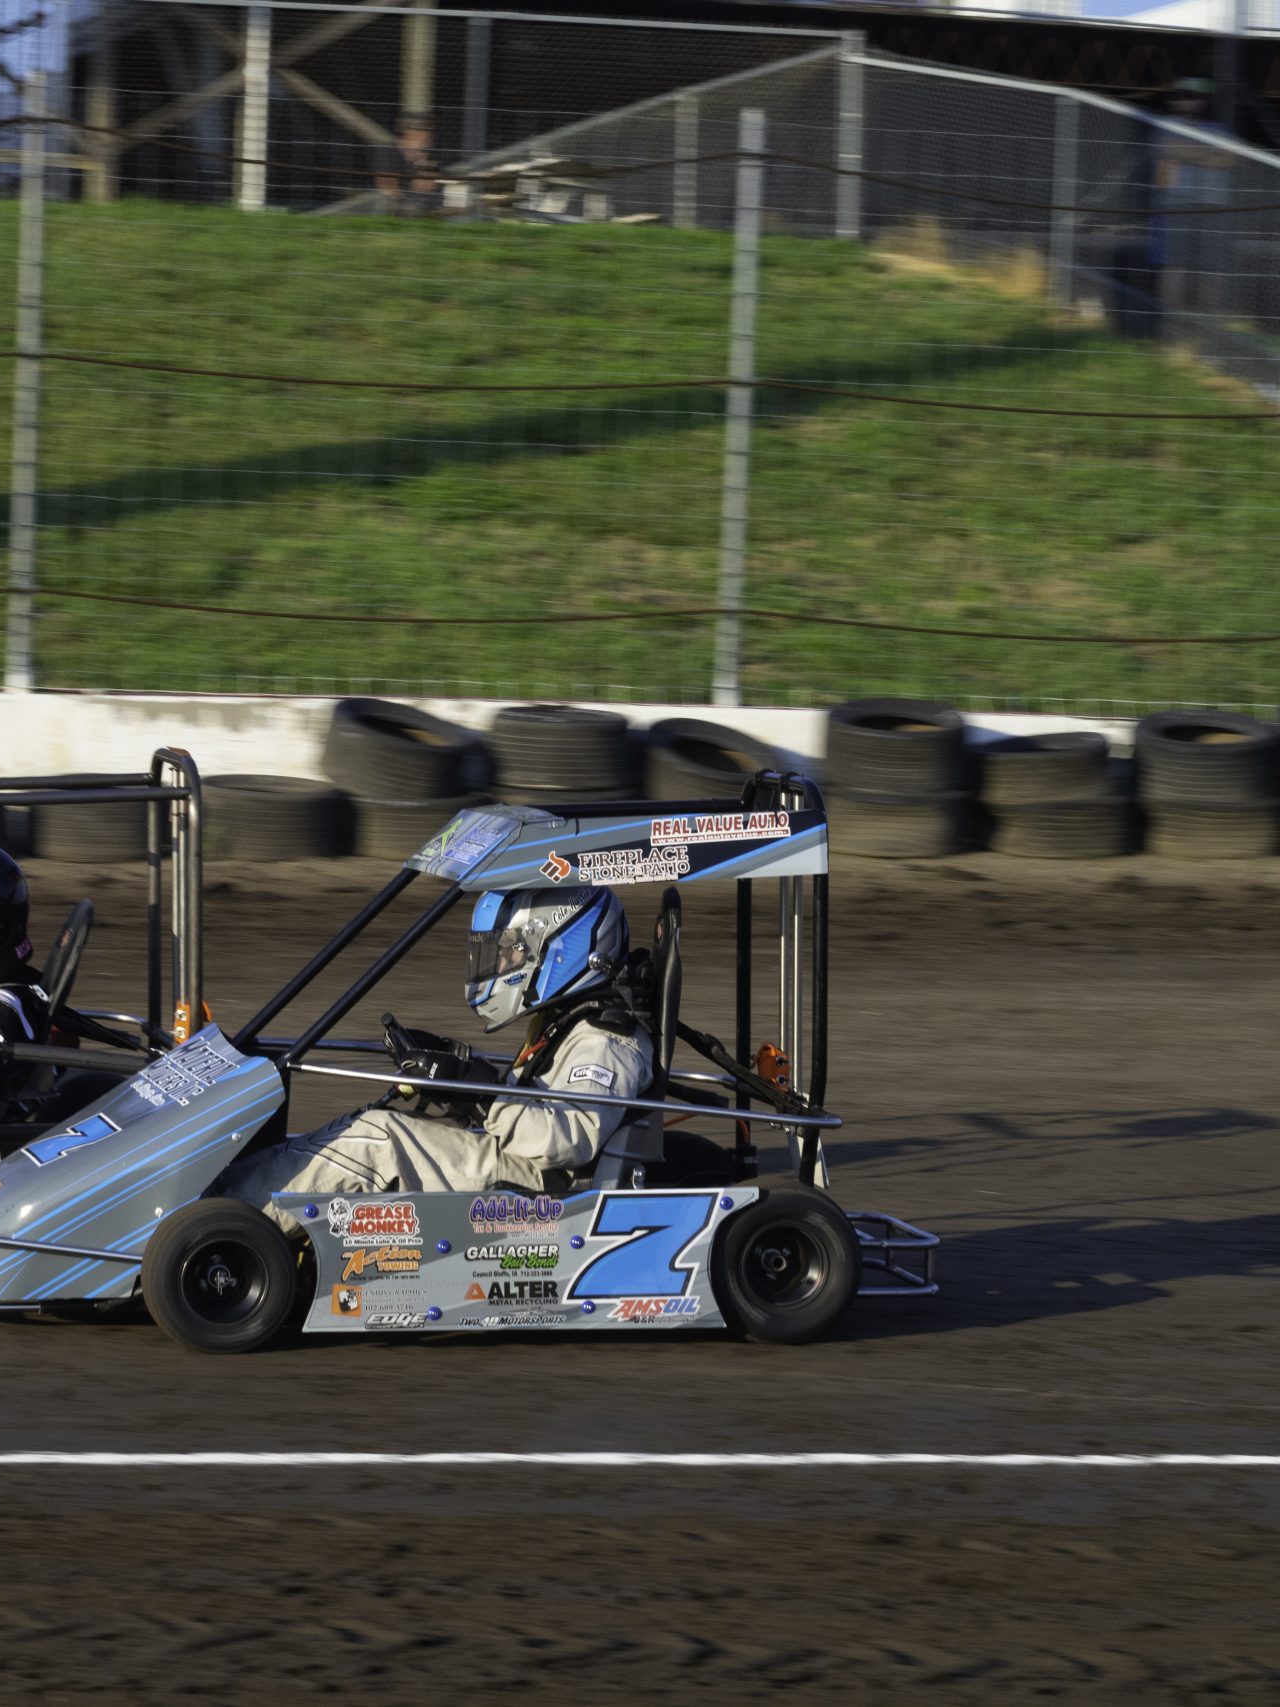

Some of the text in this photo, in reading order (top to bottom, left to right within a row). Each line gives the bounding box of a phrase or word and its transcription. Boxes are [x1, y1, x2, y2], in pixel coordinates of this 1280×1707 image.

[652, 812, 788, 836] REAL VALUE AUTO
[579, 847, 688, 868] FIREPLACE
[579, 865, 634, 881] STONE
[643, 861, 690, 877] PATIO
[20, 1112, 123, 1168] 7
[354, 1204, 414, 1220] GREASE
[470, 1196, 564, 1221] Add-It-Up
[350, 1220, 416, 1235] MONKEY
[465, 1245, 559, 1260] GALLAGHER
[561, 1188, 724, 1305] 7
[342, 1246, 422, 1281] Action
[376, 1260, 419, 1272] TOWING
[487, 1281, 559, 1299] ALTER
[366, 1312, 427, 1324] EDGE
[608, 1298, 700, 1321] AMSOIL
